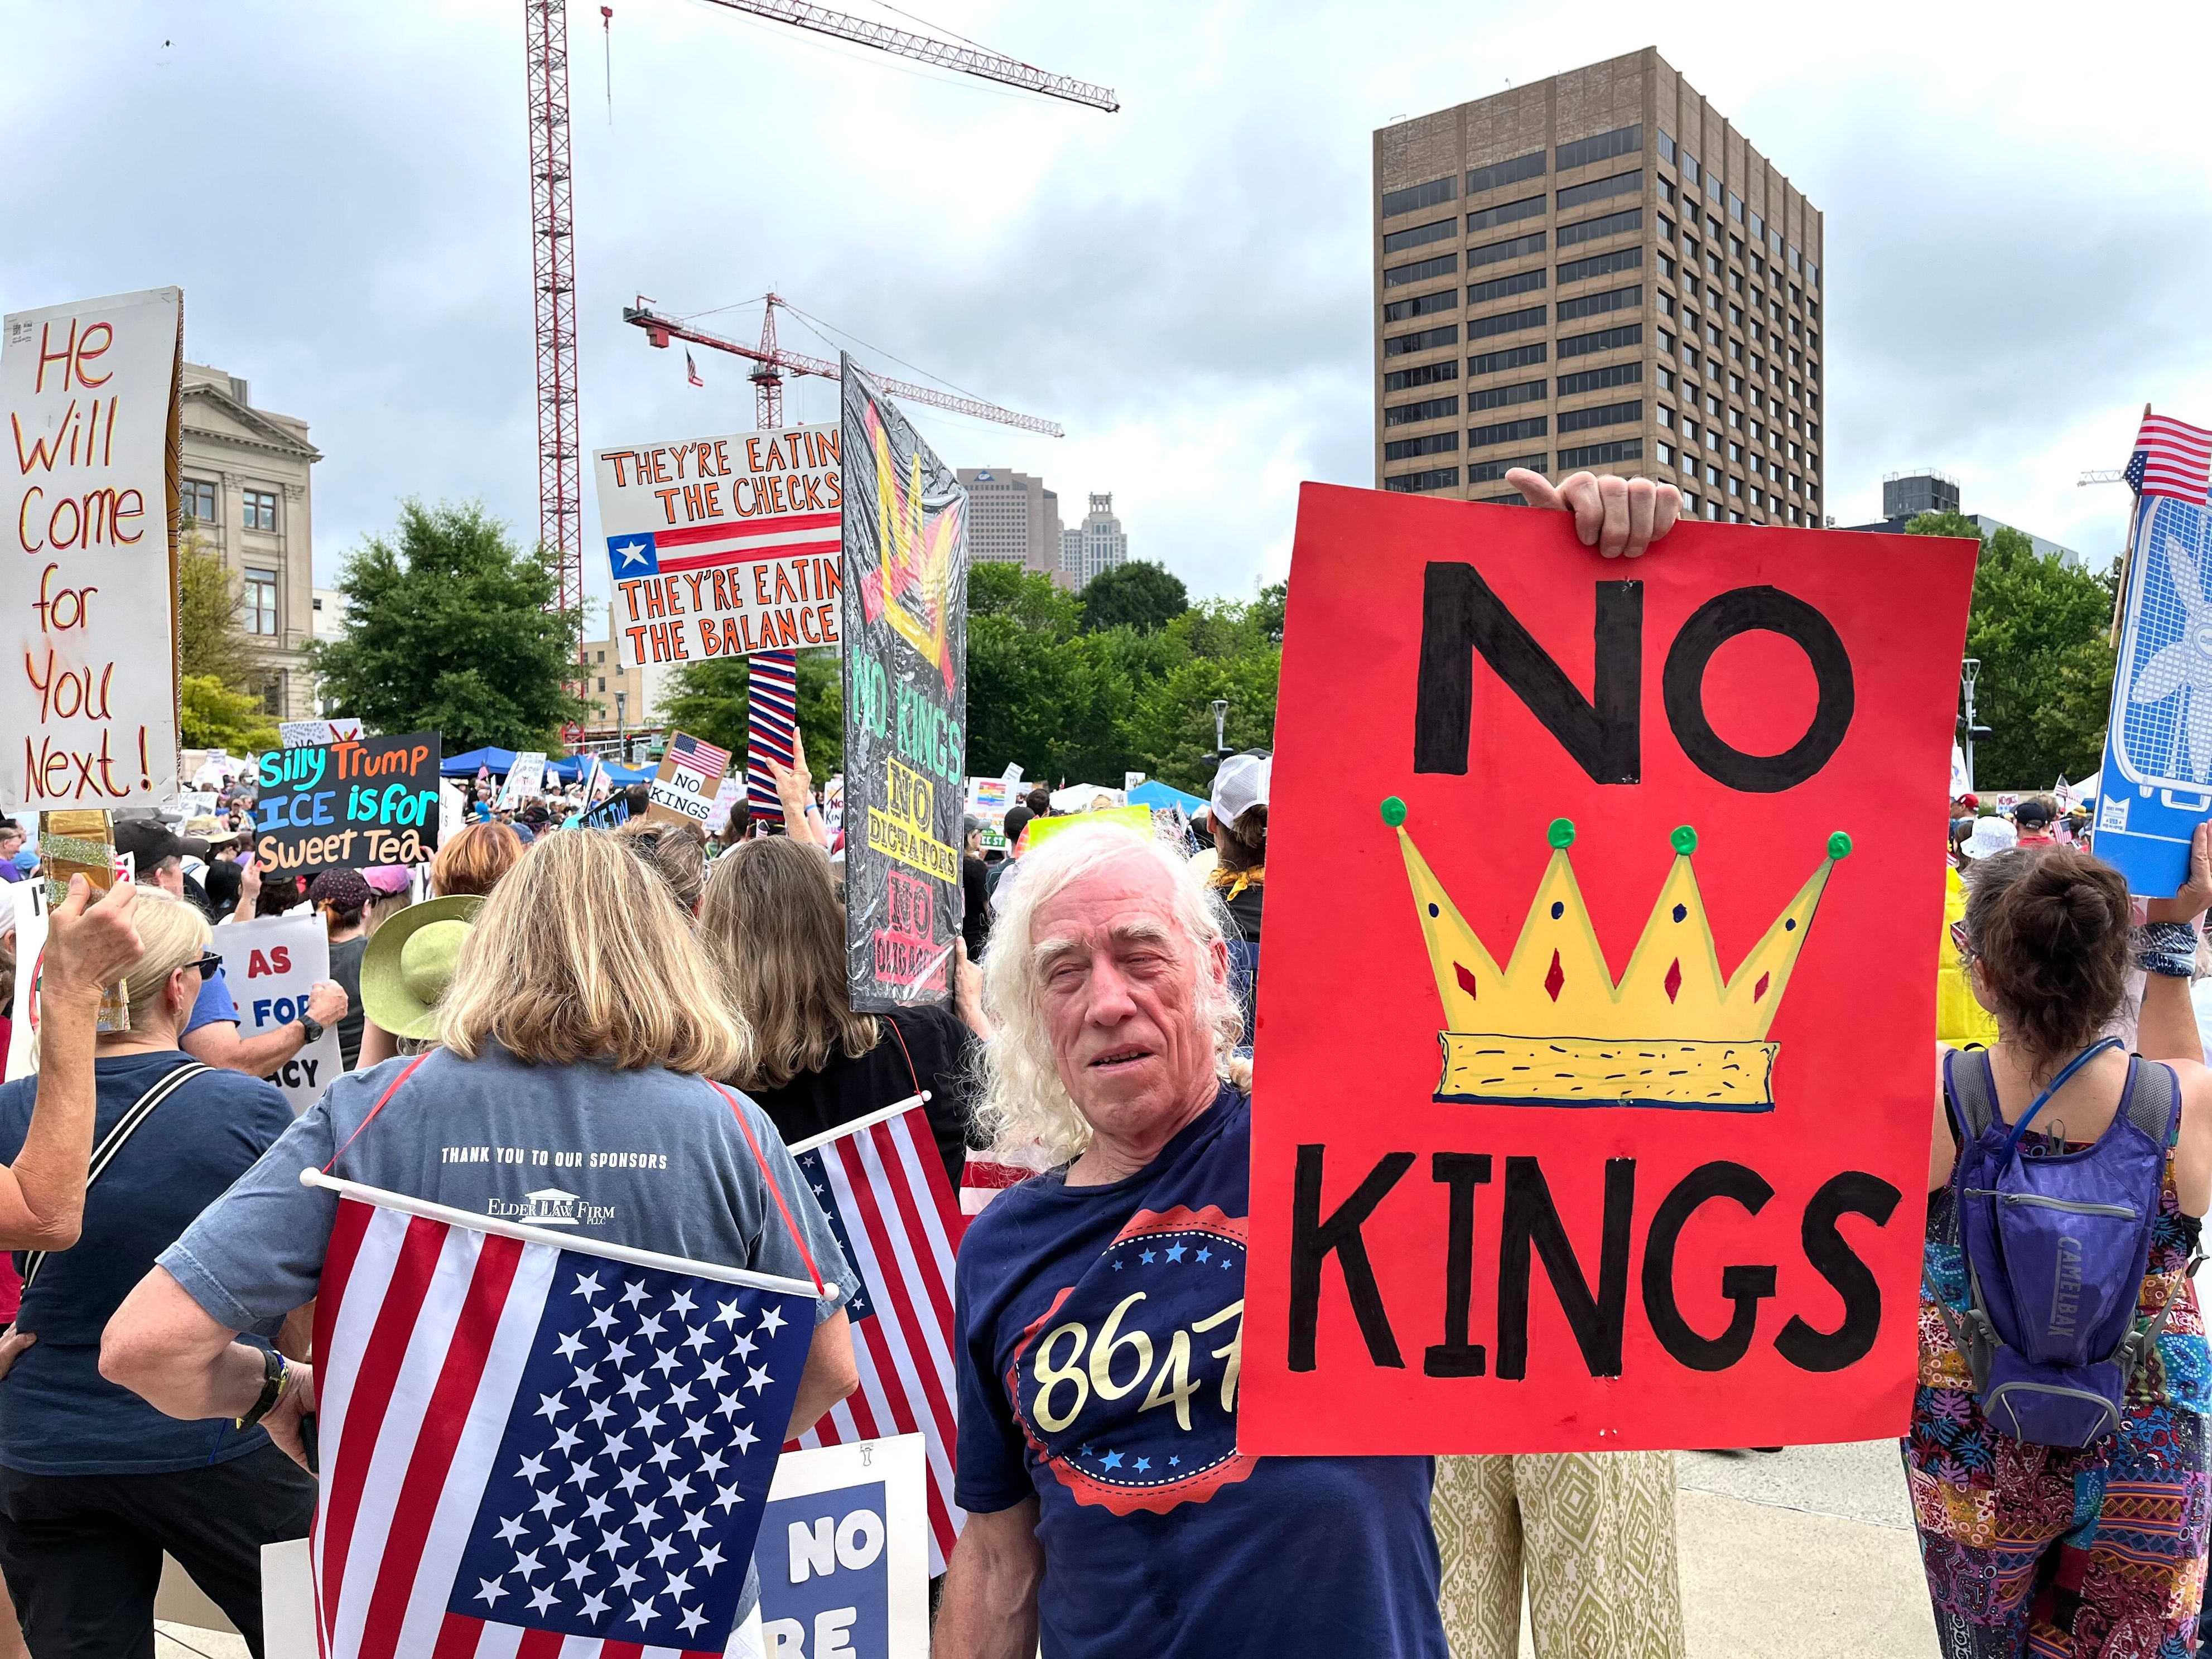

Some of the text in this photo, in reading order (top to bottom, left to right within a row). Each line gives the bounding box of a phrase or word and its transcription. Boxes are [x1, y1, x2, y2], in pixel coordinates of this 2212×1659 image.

[36, 317, 114, 394] He
[11, 395, 118, 475] Will
[601, 429, 841, 488] THEY'RE EATIN
[19, 486, 145, 553] Come
[654, 471, 843, 524] THE CHECKS
[32, 562, 98, 633] for
[619, 556, 842, 621] THEY'RE EATIN
[625, 604, 840, 665] THE BALANCE
[25, 649, 113, 724] You
[1414, 561, 1855, 793] NO
[852, 643, 962, 786] NO KINGS
[24, 725, 152, 803] Next!
[259, 741, 429, 792] Silly Trump
[673, 773, 700, 793] NO
[257, 790, 336, 833] ICE
[650, 786, 711, 820] KINGS
[890, 762, 932, 833] NO
[257, 828, 426, 873] Sweet Tea
[869, 813, 957, 877] DICTATORS
[891, 876, 930, 939] NO
[248, 946, 291, 978] AS
[442, 1146, 668, 1170] THANK YOU TO OUR SPONSORS
[586, 1217, 607, 1226] PLLC
[1288, 1143, 1902, 1380] KINGS
[2047, 1236, 2083, 1339] CAMELBAK
[1033, 1291, 1244, 1432] 8647
[788, 1509, 884, 1584] NO
